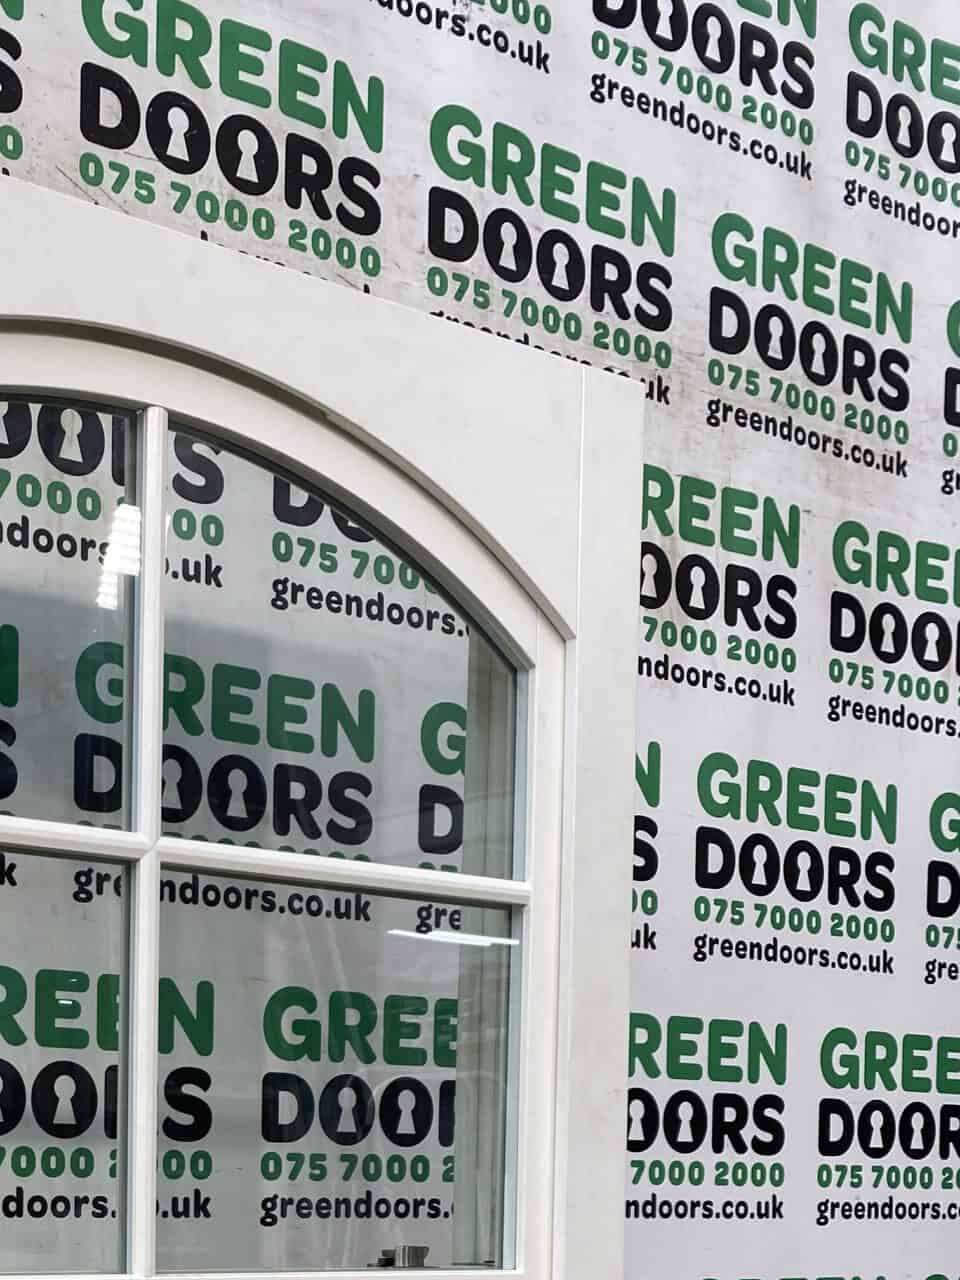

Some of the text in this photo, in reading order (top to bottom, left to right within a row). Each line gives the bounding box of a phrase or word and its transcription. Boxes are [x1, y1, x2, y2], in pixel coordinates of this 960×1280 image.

[468, 0, 552, 34] 000
[81, 0, 385, 153] GREEN
[591, 30, 814, 146] 075 7000 2000
[81, 62, 382, 236] DOORS
[590, 73, 813, 181] greendoors.co.uk
[79, 152, 382, 277] 075 7000 2000
[429, 104, 676, 257] GREEN
[844, 140, 960, 208] 075 7000
[428, 186, 673, 332] DOORS
[711, 212, 913, 344] GREEN
[427, 267, 491, 310] 075
[501, 289, 582, 341] 7000
[593, 321, 672, 369] 2000
[709, 286, 910, 412] DOORS
[705, 398, 908, 478] greendoors.co.uk
[707, 358, 909, 445] 075 7000 2000
[272, 532, 438, 594] 075 700
[832, 520, 960, 608] GRE
[271, 577, 468, 637] greendoors.
[642, 616, 797, 673] 7000 2000
[829, 590, 960, 678] DOO
[75, 641, 376, 763] GREEN
[829, 658, 949, 704] 075 7000
[73, 733, 374, 845] DOORS
[697, 752, 897, 845] GREEN
[72, 866, 371, 922] grndoors.co.uk
[695, 825, 895, 912] DOORS
[693, 933, 893, 975] greendoors.co.uk
[694, 895, 895, 943] 075 7000 2000
[925, 924, 960, 949] 07
[260, 1151, 328, 1182] 075
[342, 1153, 430, 1183] 7000
[260, 1190, 454, 1227] greendoors.
[630, 1159, 785, 1187] 7000 2000
[816, 1164, 863, 1189] 075
[871, 1165, 933, 1190] 7000
[816, 1196, 960, 1226] greendoors.c
